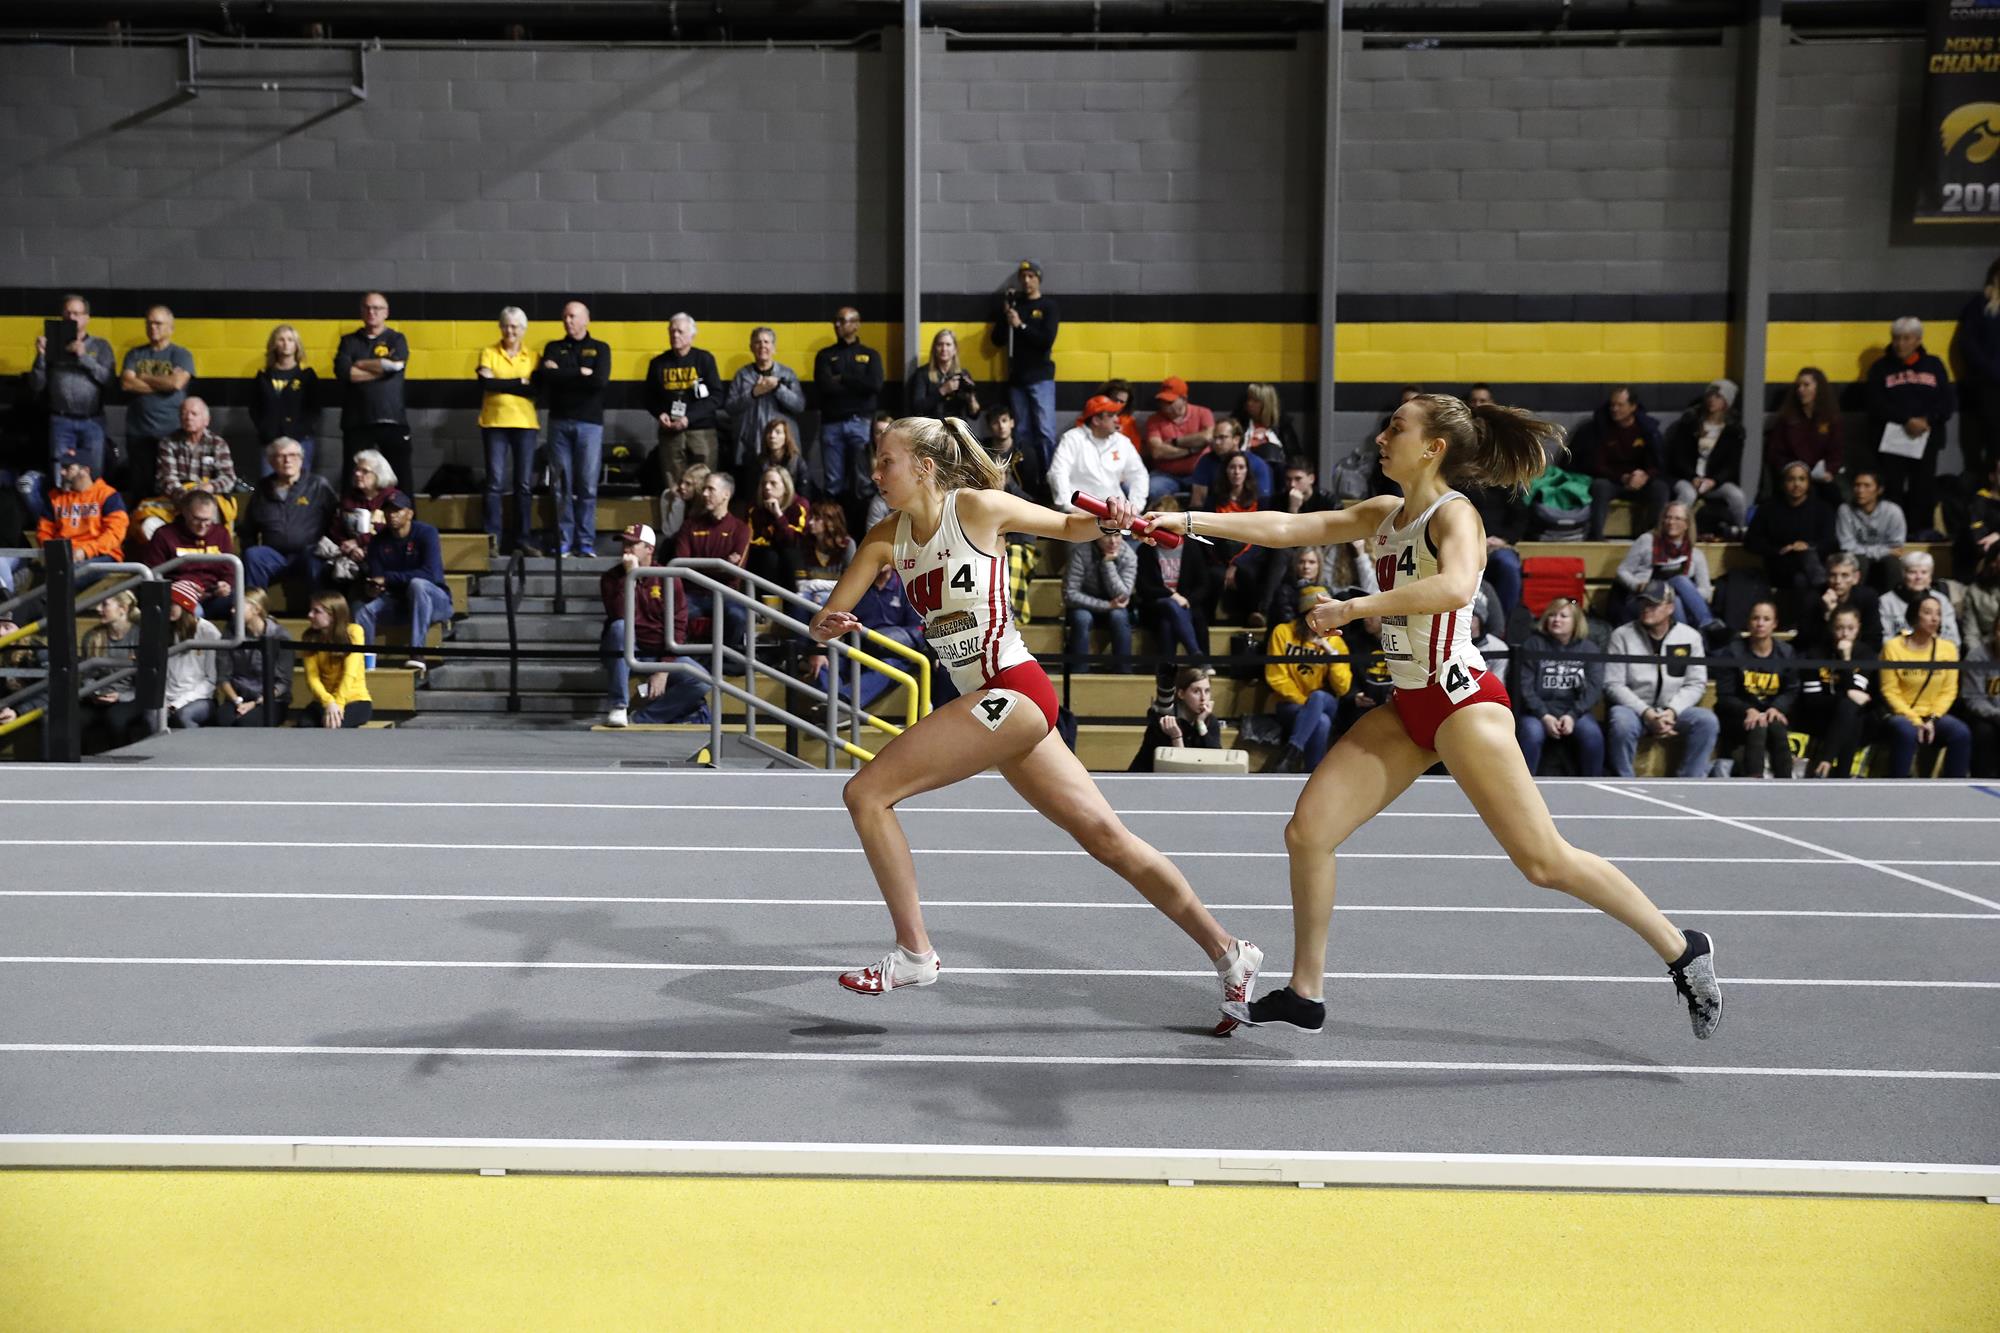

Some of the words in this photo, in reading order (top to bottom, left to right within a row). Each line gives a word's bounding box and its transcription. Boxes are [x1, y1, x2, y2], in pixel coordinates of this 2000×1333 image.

[663, 366, 698, 382] IOWA
[1397, 545, 1416, 576] 4
[950, 563, 975, 593] 4
[1445, 663, 1470, 693] 4
[980, 696, 1009, 722] 4
